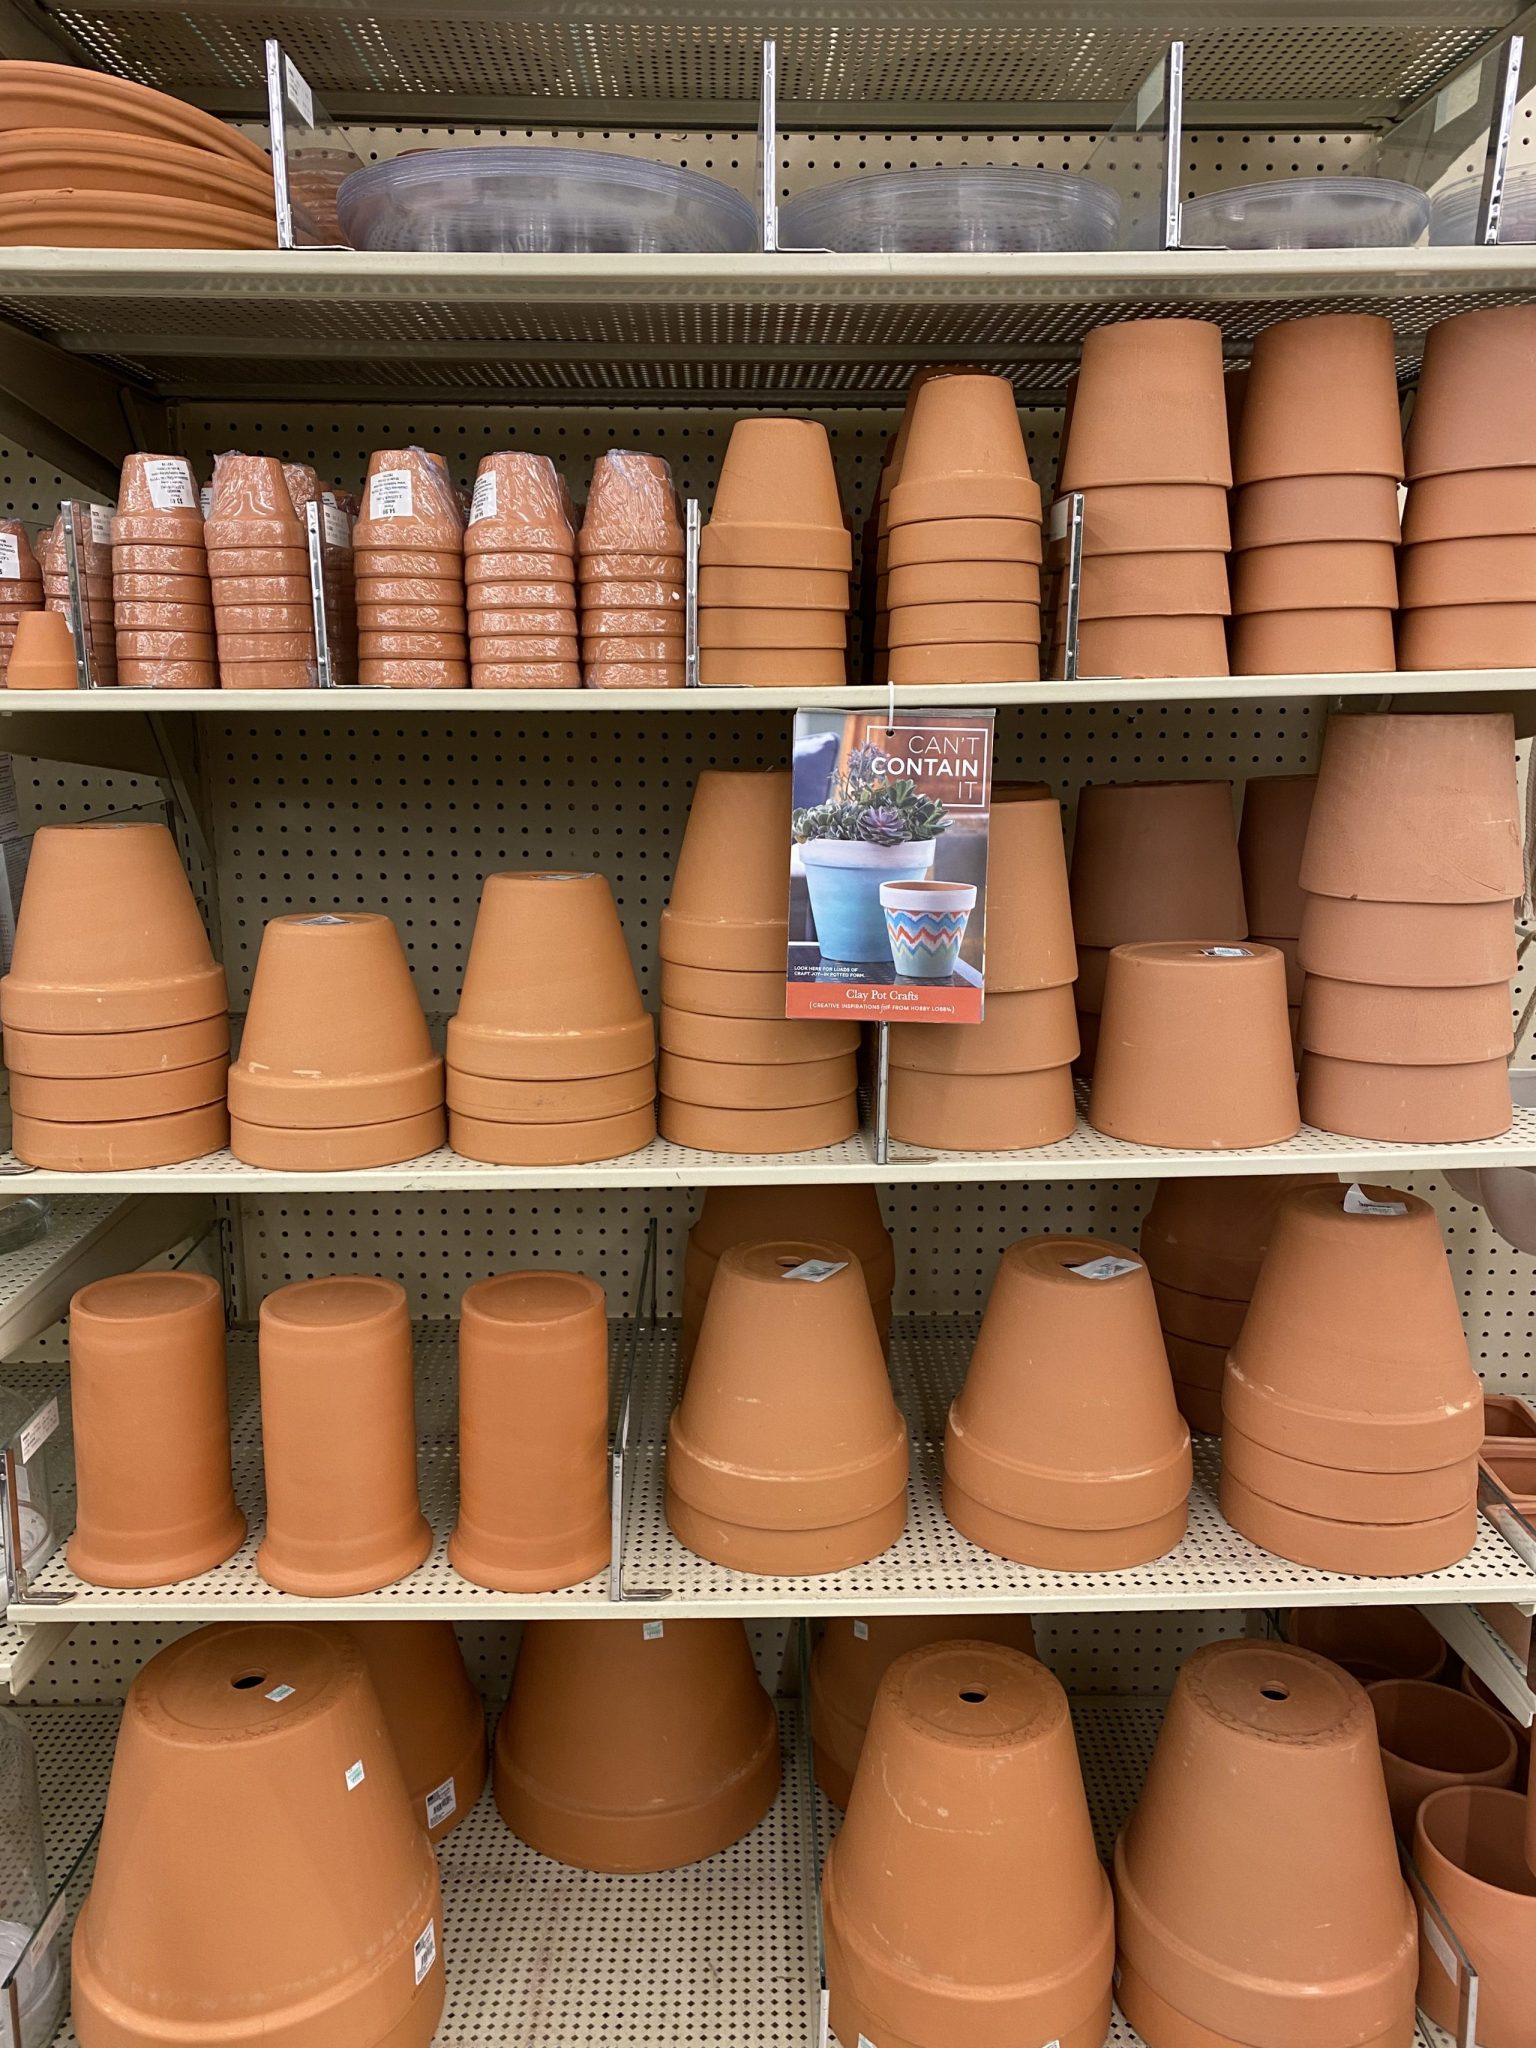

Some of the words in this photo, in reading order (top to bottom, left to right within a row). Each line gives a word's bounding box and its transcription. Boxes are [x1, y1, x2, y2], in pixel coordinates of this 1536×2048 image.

[908, 735, 980, 755] CAN’T
[871, 756, 978, 777] CONTAIN
[958, 781, 978, 799] IT
[845, 989, 869, 1001] Clay
[871, 990, 887, 1000] Pot
[889, 990, 919, 1001] Crafts
